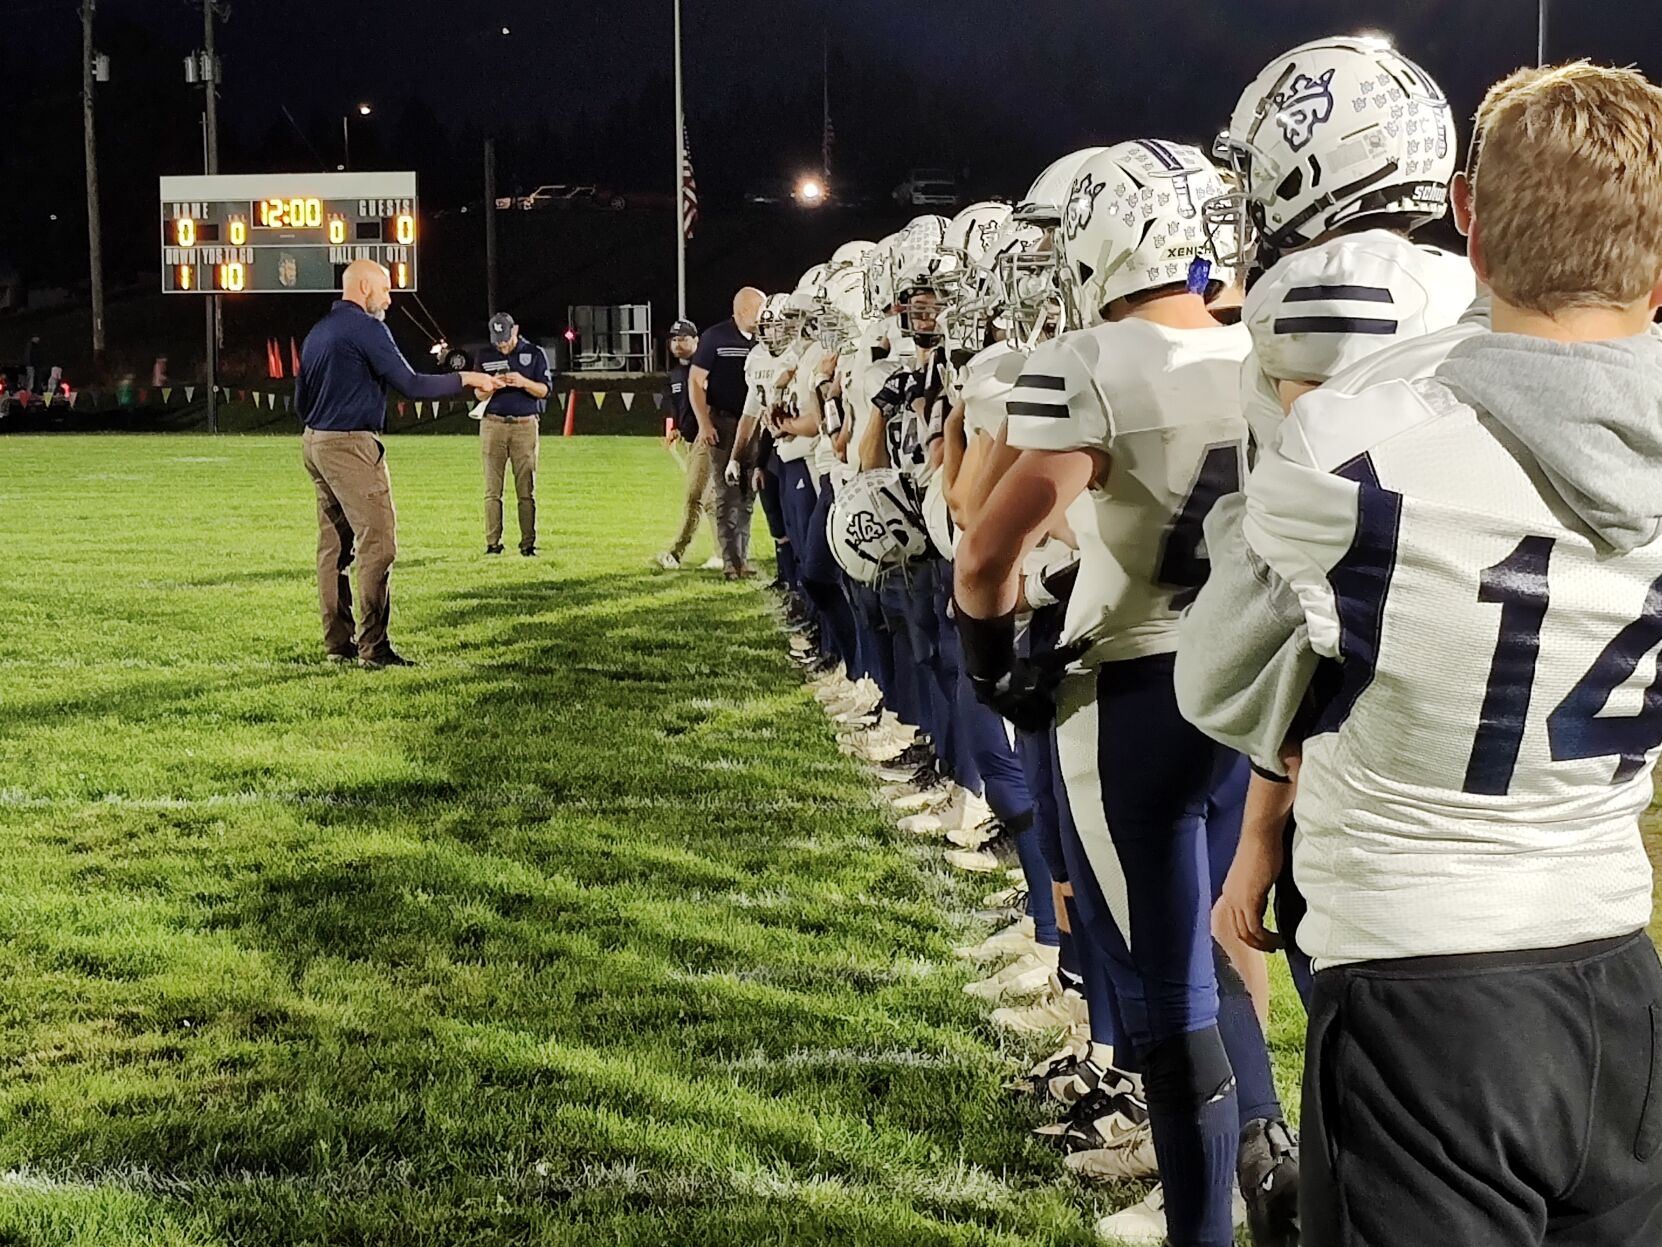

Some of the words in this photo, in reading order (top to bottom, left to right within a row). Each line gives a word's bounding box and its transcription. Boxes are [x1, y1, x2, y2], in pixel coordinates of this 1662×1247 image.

[173, 203, 208, 219] HOME
[260, 199, 321, 228] 12:00
[359, 200, 410, 217] GUESTS
[178, 218, 195, 247] 0
[230, 222, 245, 245] 0
[330, 220, 344, 244] 0
[397, 215, 414, 245] 0
[166, 248, 196, 265] DOWN
[386, 246, 408, 263] QTR
[180, 264, 190, 290] 1
[220, 262, 244, 291] 10
[398, 262, 407, 289] 1
[1463, 535, 1661, 796] 14
